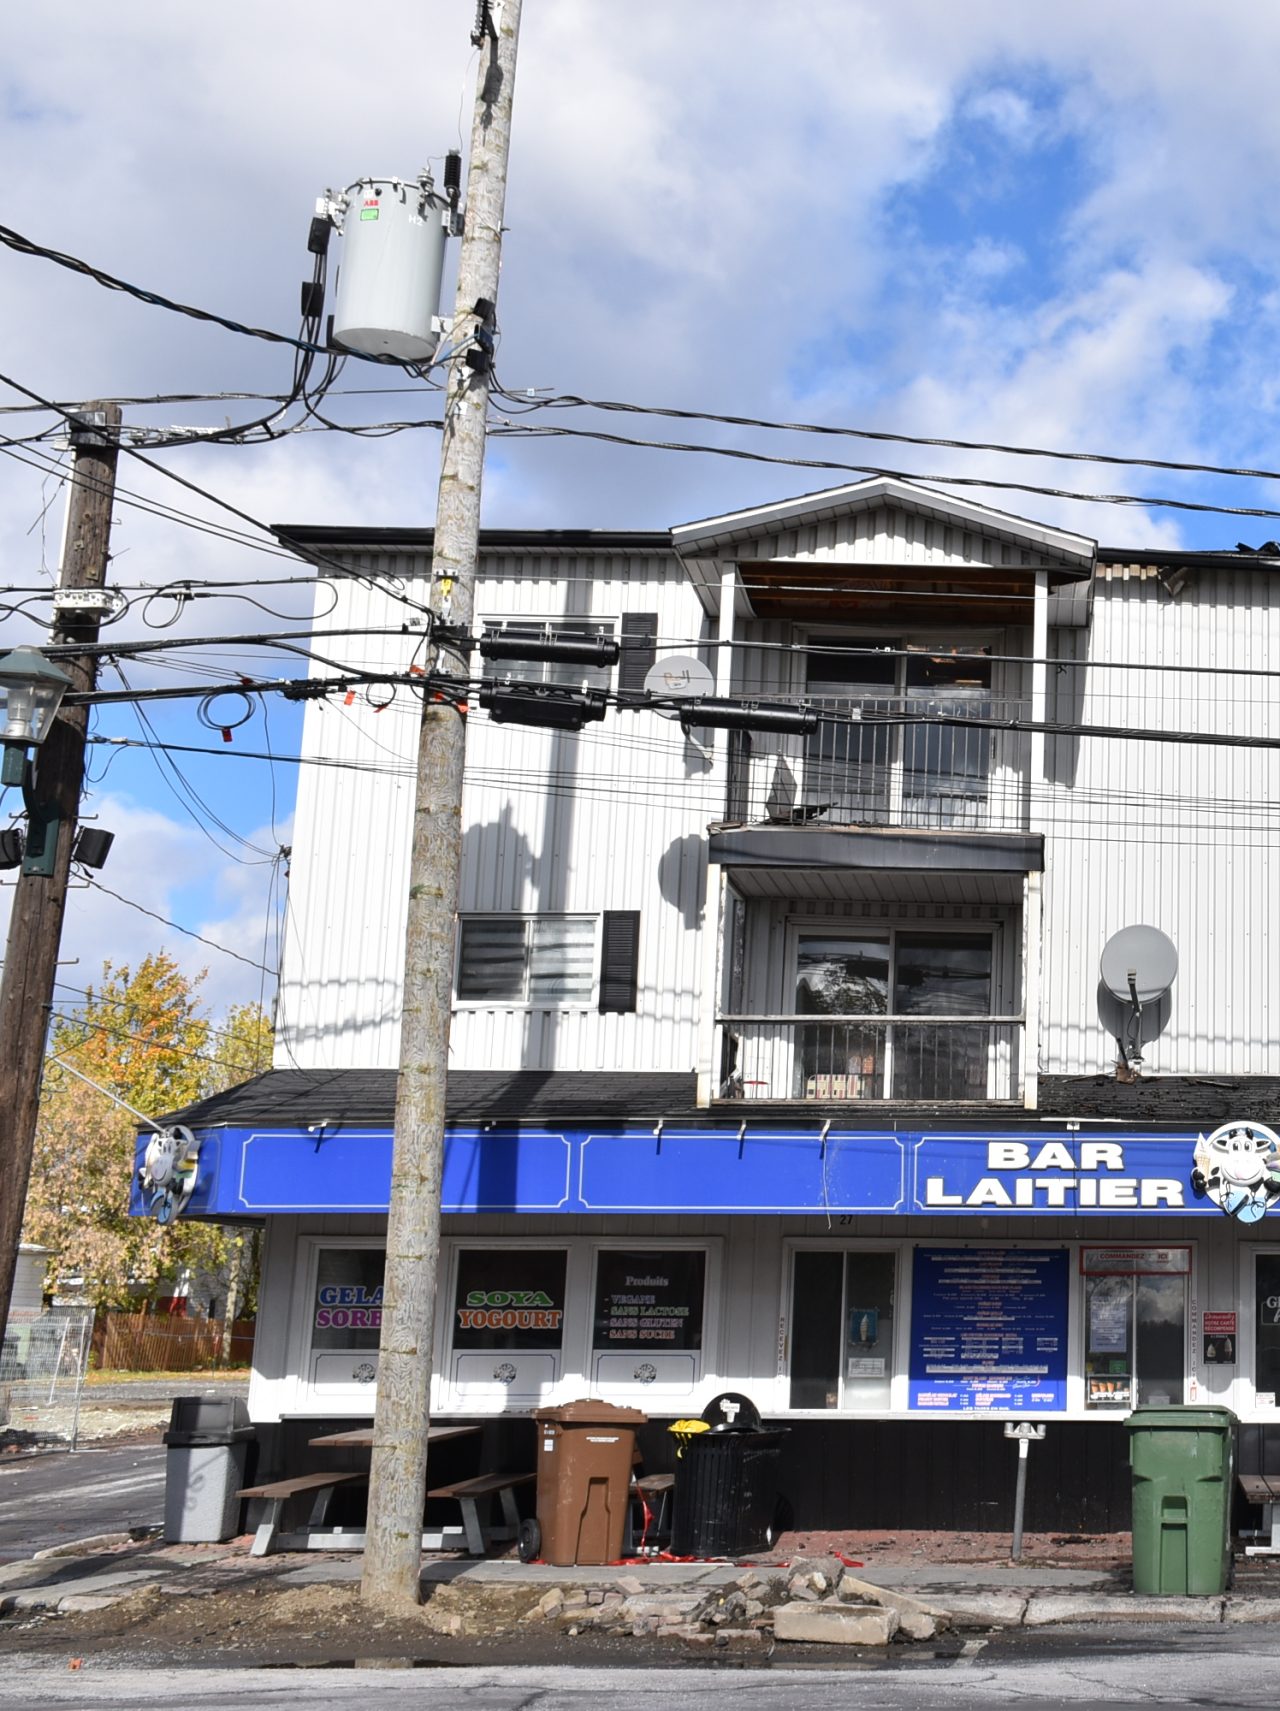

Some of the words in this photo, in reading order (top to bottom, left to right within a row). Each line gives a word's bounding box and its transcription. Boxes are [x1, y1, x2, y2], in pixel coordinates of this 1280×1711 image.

[409, 214, 423, 226] H2
[987, 1141, 1125, 1171] BAR
[926, 1177, 1185, 1207] LAITIER
[839, 1214, 853, 1226] 27
[624, 1275, 669, 1287] Produits
[319, 1286, 384, 1306] GELA
[466, 1290, 554, 1307] SOYA
[316, 1308, 382, 1328] SORB
[610, 1306, 639, 1316] SANS
[639, 1306, 689, 1316] LACTOSE
[457, 1309, 563, 1329] YOGOURT
[609, 1317, 638, 1328] SANS
[639, 1318, 683, 1328] GLUTEN
[608, 1329, 638, 1339] SANS
[638, 1329, 675, 1340] SUCRE
